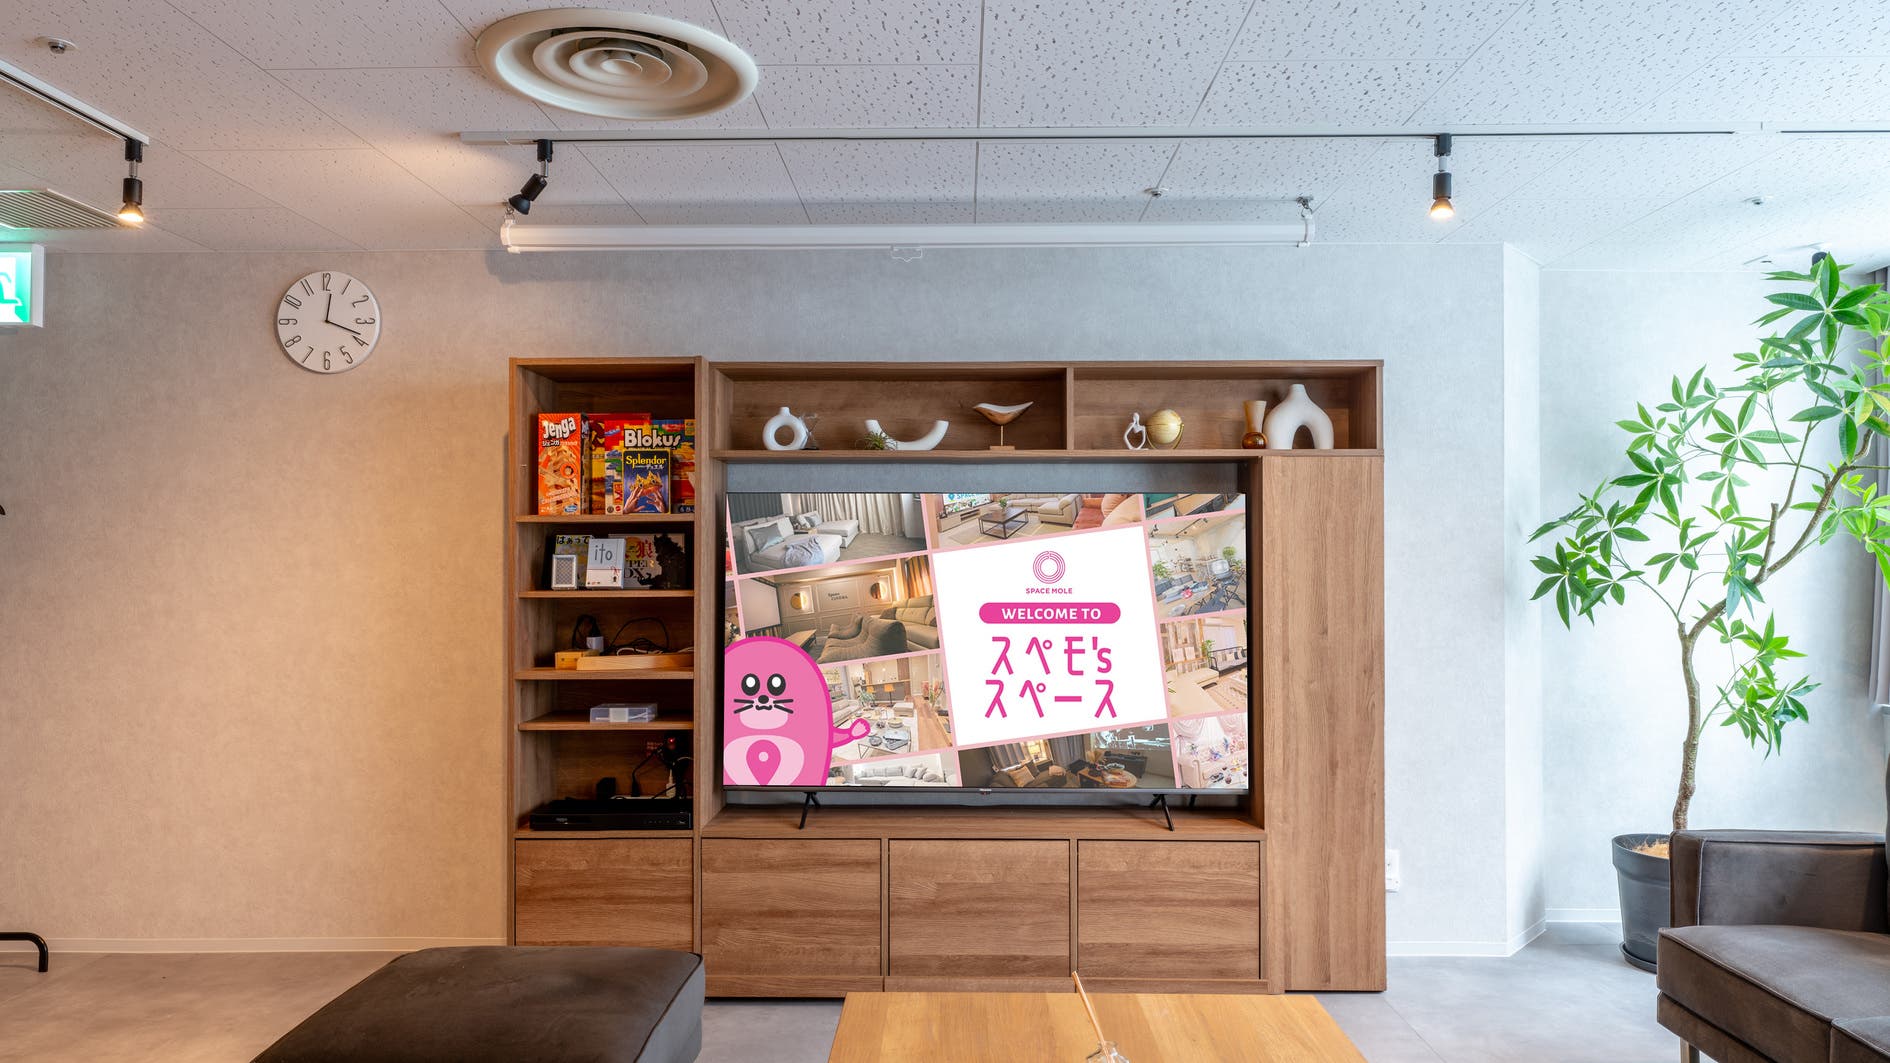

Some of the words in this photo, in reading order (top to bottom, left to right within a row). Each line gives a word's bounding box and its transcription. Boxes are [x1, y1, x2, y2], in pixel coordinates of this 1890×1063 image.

[322, 273, 332, 292] 12
[342, 280, 352, 296] 1
[284, 295, 303, 310] 10
[352, 295, 370, 309] 2
[285, 336, 302, 349] 8
[352, 336, 370, 347] 4
[302, 346, 315, 364] 7
[324, 351, 331, 371] 6
[340, 346, 354, 365] 5
[542, 416, 576, 439] Jenga
[624, 429, 681, 448] Blokus
[626, 453, 667, 468] Splendor
[594, 543, 613, 564] ito
[1001, 608, 1077, 620] WELCOME
[1081, 608, 1102, 620] TO
[991, 636, 1112, 676] スペモ's
[984, 679, 1117, 718] スペース
